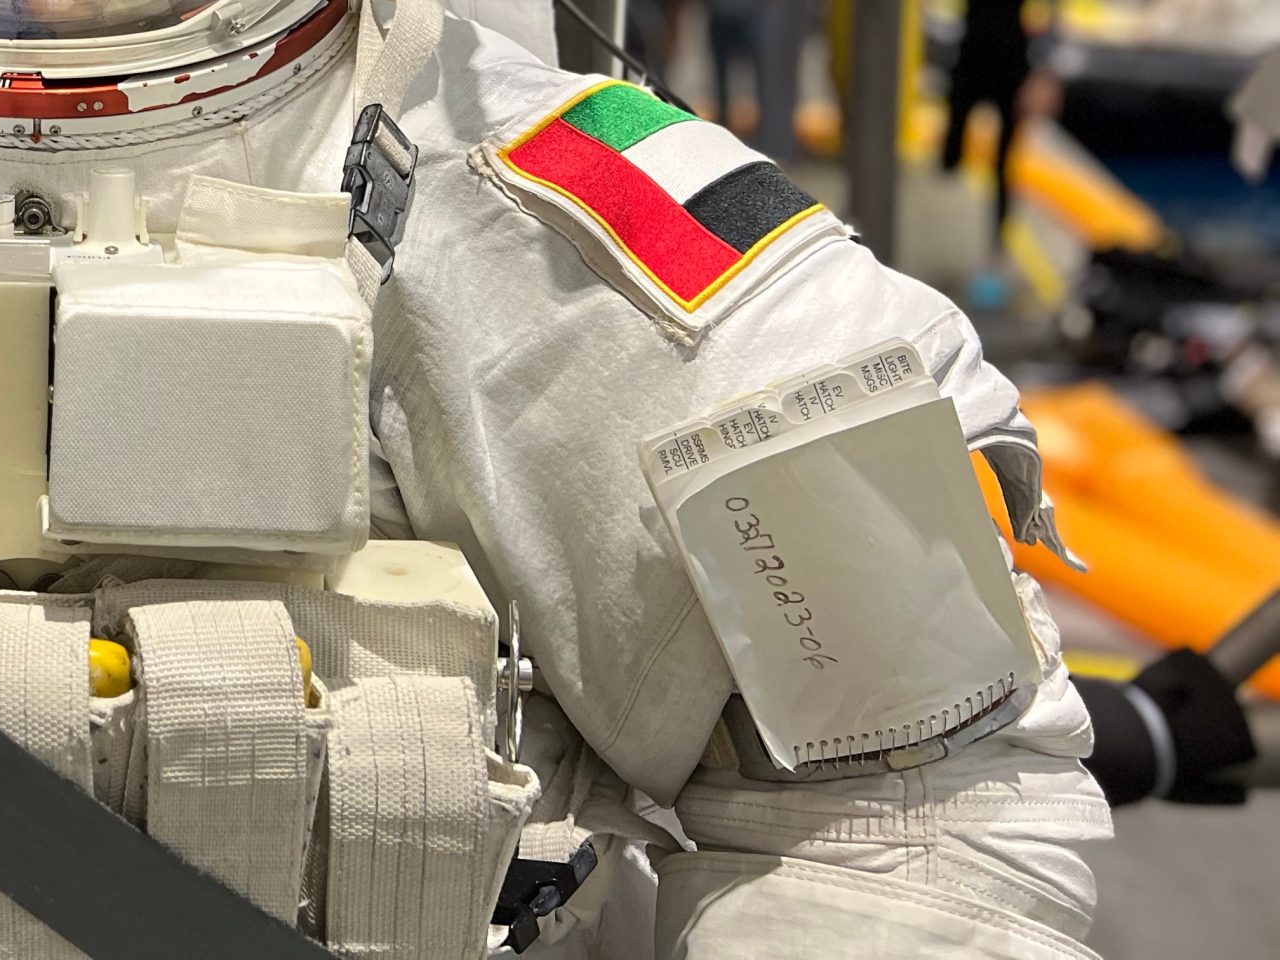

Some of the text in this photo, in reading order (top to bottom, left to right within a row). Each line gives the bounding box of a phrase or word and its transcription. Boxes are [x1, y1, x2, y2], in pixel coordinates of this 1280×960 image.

[872, 362, 888, 387] MISC
[884, 355, 903, 382] LIGHT
[897, 354, 913, 375] BITE
[832, 385, 845, 398] EV
[860, 365, 878, 393] MSGS
[794, 390, 813, 421] HATCH
[808, 395, 820, 405] IV
[817, 380, 837, 412] HATCH
[743, 422, 756, 435] EV
[752, 409, 773, 440] HATCH
[767, 414, 780, 424] IV
[728, 418, 749, 448] HATCH
[669, 447, 685, 468] SCU
[680, 439, 699, 468] DRIVE
